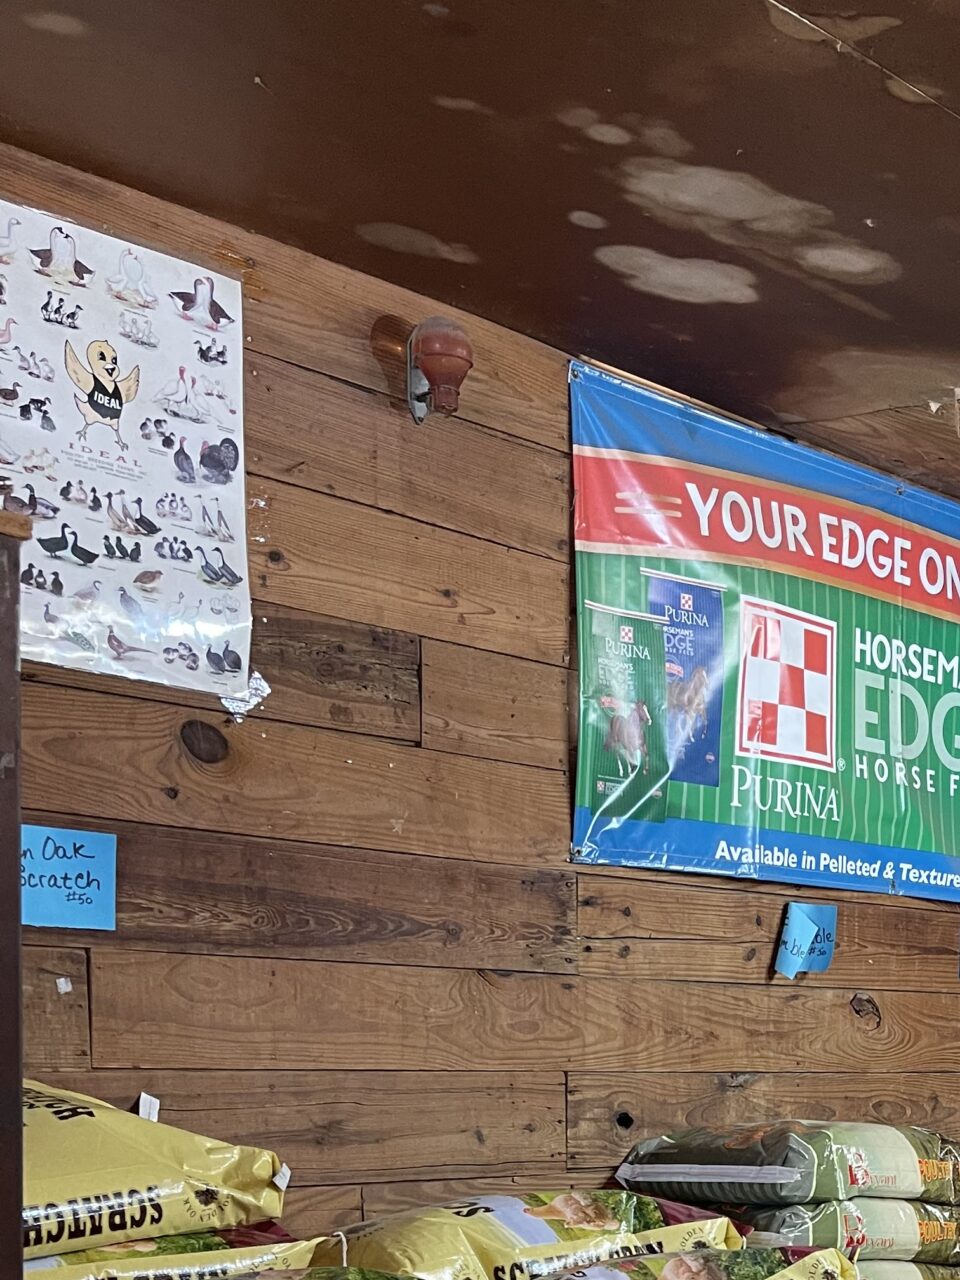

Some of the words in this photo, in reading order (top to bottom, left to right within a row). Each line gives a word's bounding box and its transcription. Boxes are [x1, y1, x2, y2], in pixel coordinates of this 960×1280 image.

[94, 391, 121, 410] IDEAL
[68, 442, 142, 468] IDEAL
[685, 482, 814, 557] YOUR
[819, 512, 911, 586] EDGE
[664, 604, 709, 628] PURINA
[605, 637, 651, 660] PURINA
[664, 633, 695, 651] DGE
[855, 754, 936, 793] HORSE
[730, 765, 840, 822] PURINA
[42, 836, 95, 861] Oak
[714, 840, 797, 868] Available
[802, 850, 816, 870] in
[819, 852, 881, 878] Pelleted
[883, 862, 895, 879] &
[22, 1185, 163, 1247] SCRATCH
[917, 1220, 956, 1245] POULTRY
